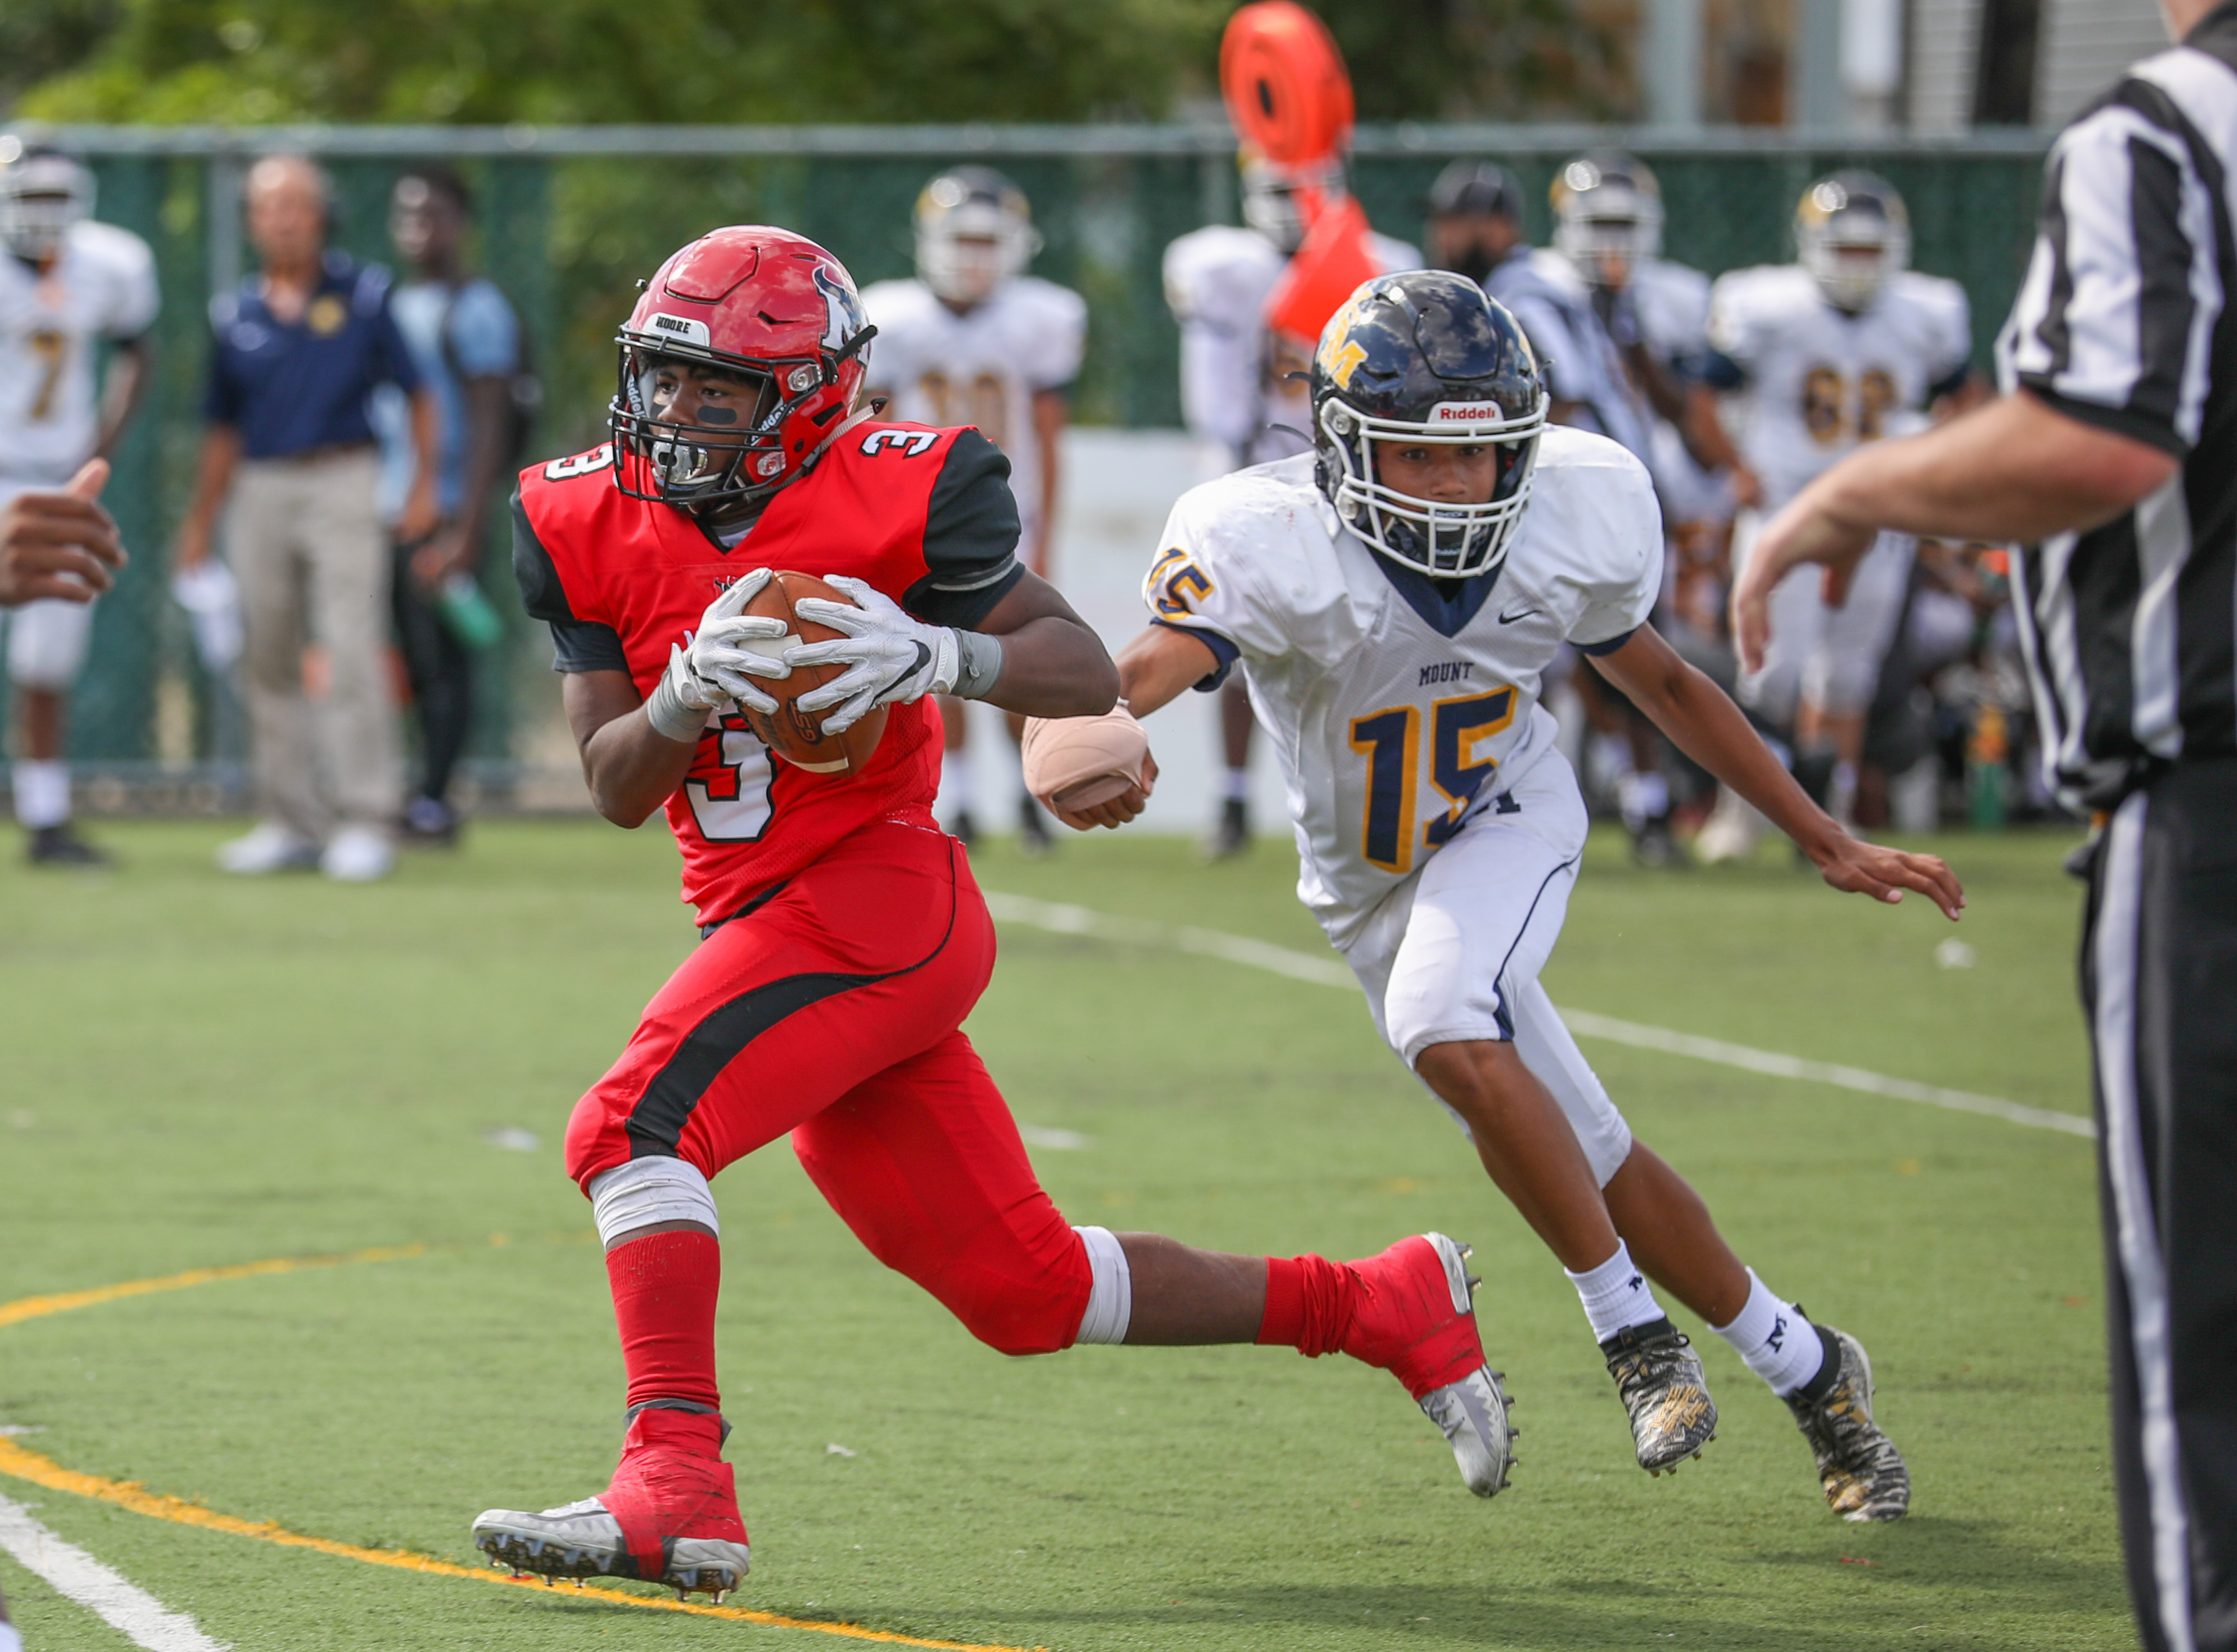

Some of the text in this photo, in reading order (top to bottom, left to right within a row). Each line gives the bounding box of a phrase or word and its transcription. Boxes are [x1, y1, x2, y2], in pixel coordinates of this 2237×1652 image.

[655, 316, 691, 334] MOORE
[1440, 408, 1495, 419] Riddell
[861, 429, 941, 458] 3
[1419, 662, 1475, 687] MOUNT
[684, 698, 777, 843] 3
[1349, 684, 1519, 874] 15
